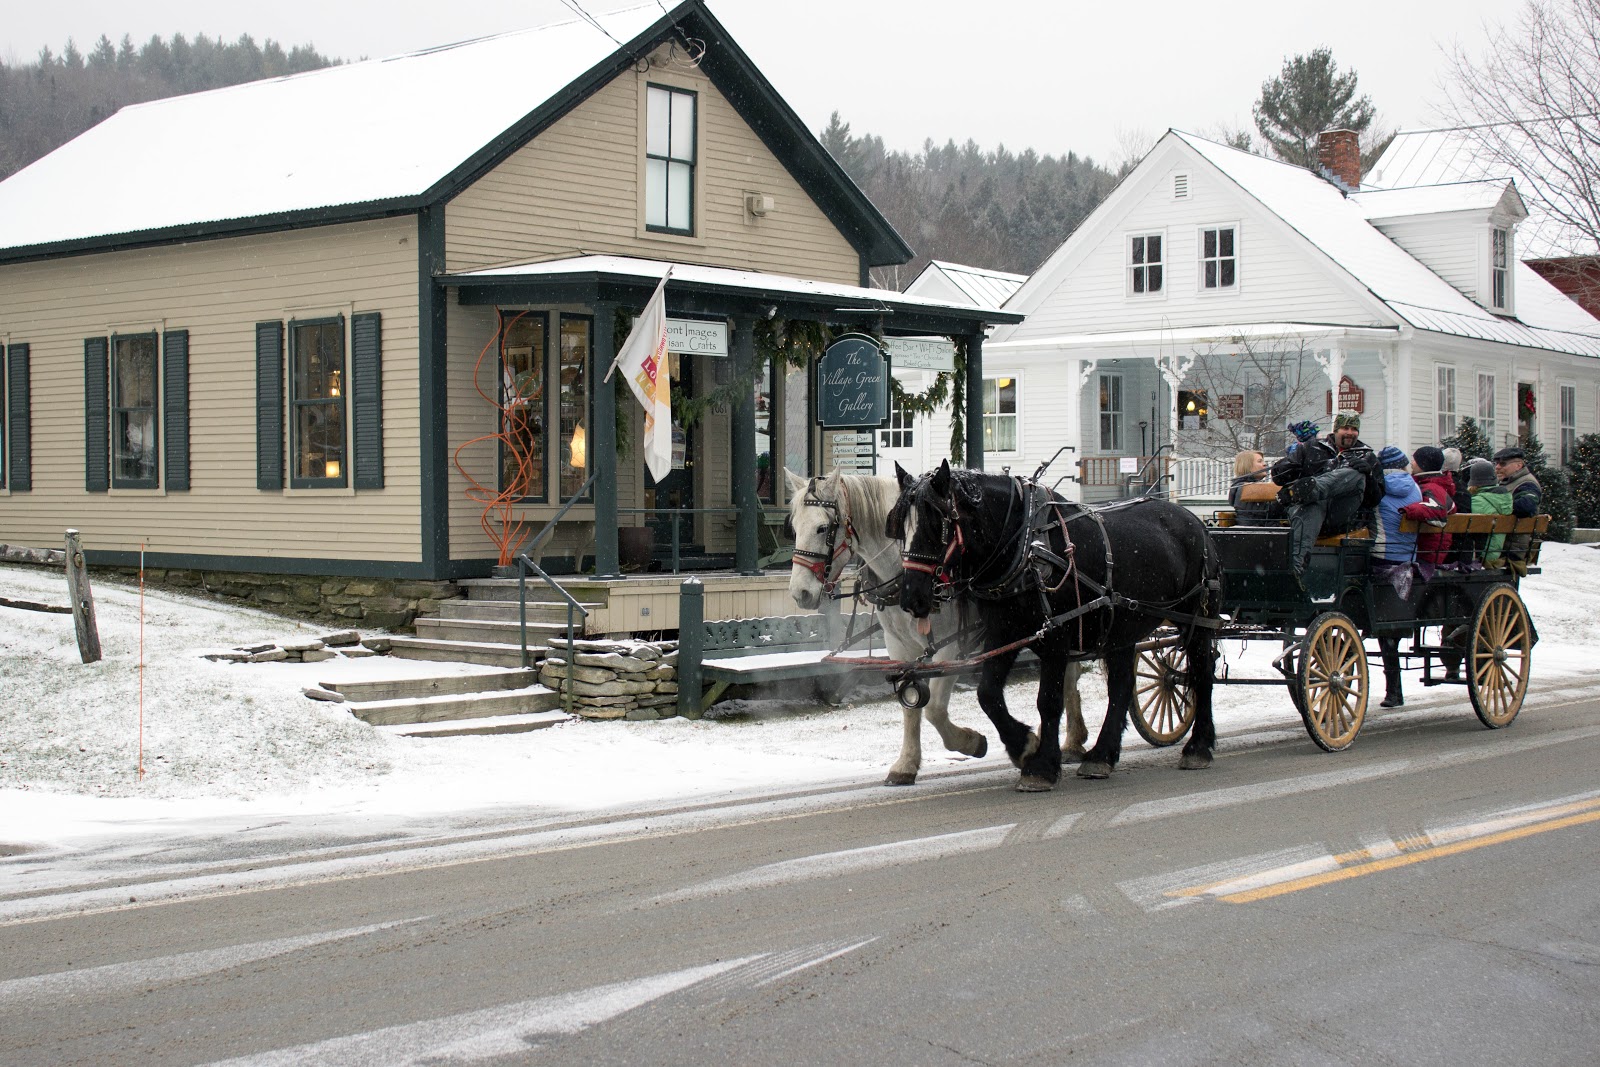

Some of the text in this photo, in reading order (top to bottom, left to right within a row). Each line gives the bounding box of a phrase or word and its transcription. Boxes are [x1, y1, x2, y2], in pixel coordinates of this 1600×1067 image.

[666, 326, 683, 335] ont
[685, 323, 718, 340] Images
[668, 337, 717, 350] isan Crafts
[903, 341, 914, 352] Bar
[845, 346, 865, 365] The
[822, 367, 883, 397] Village Green
[1338, 393, 1360, 401] RMONT
[838, 392, 874, 420] Gallery
[834, 435, 854, 443] Coffee
[853, 446, 870, 454] Crafts
